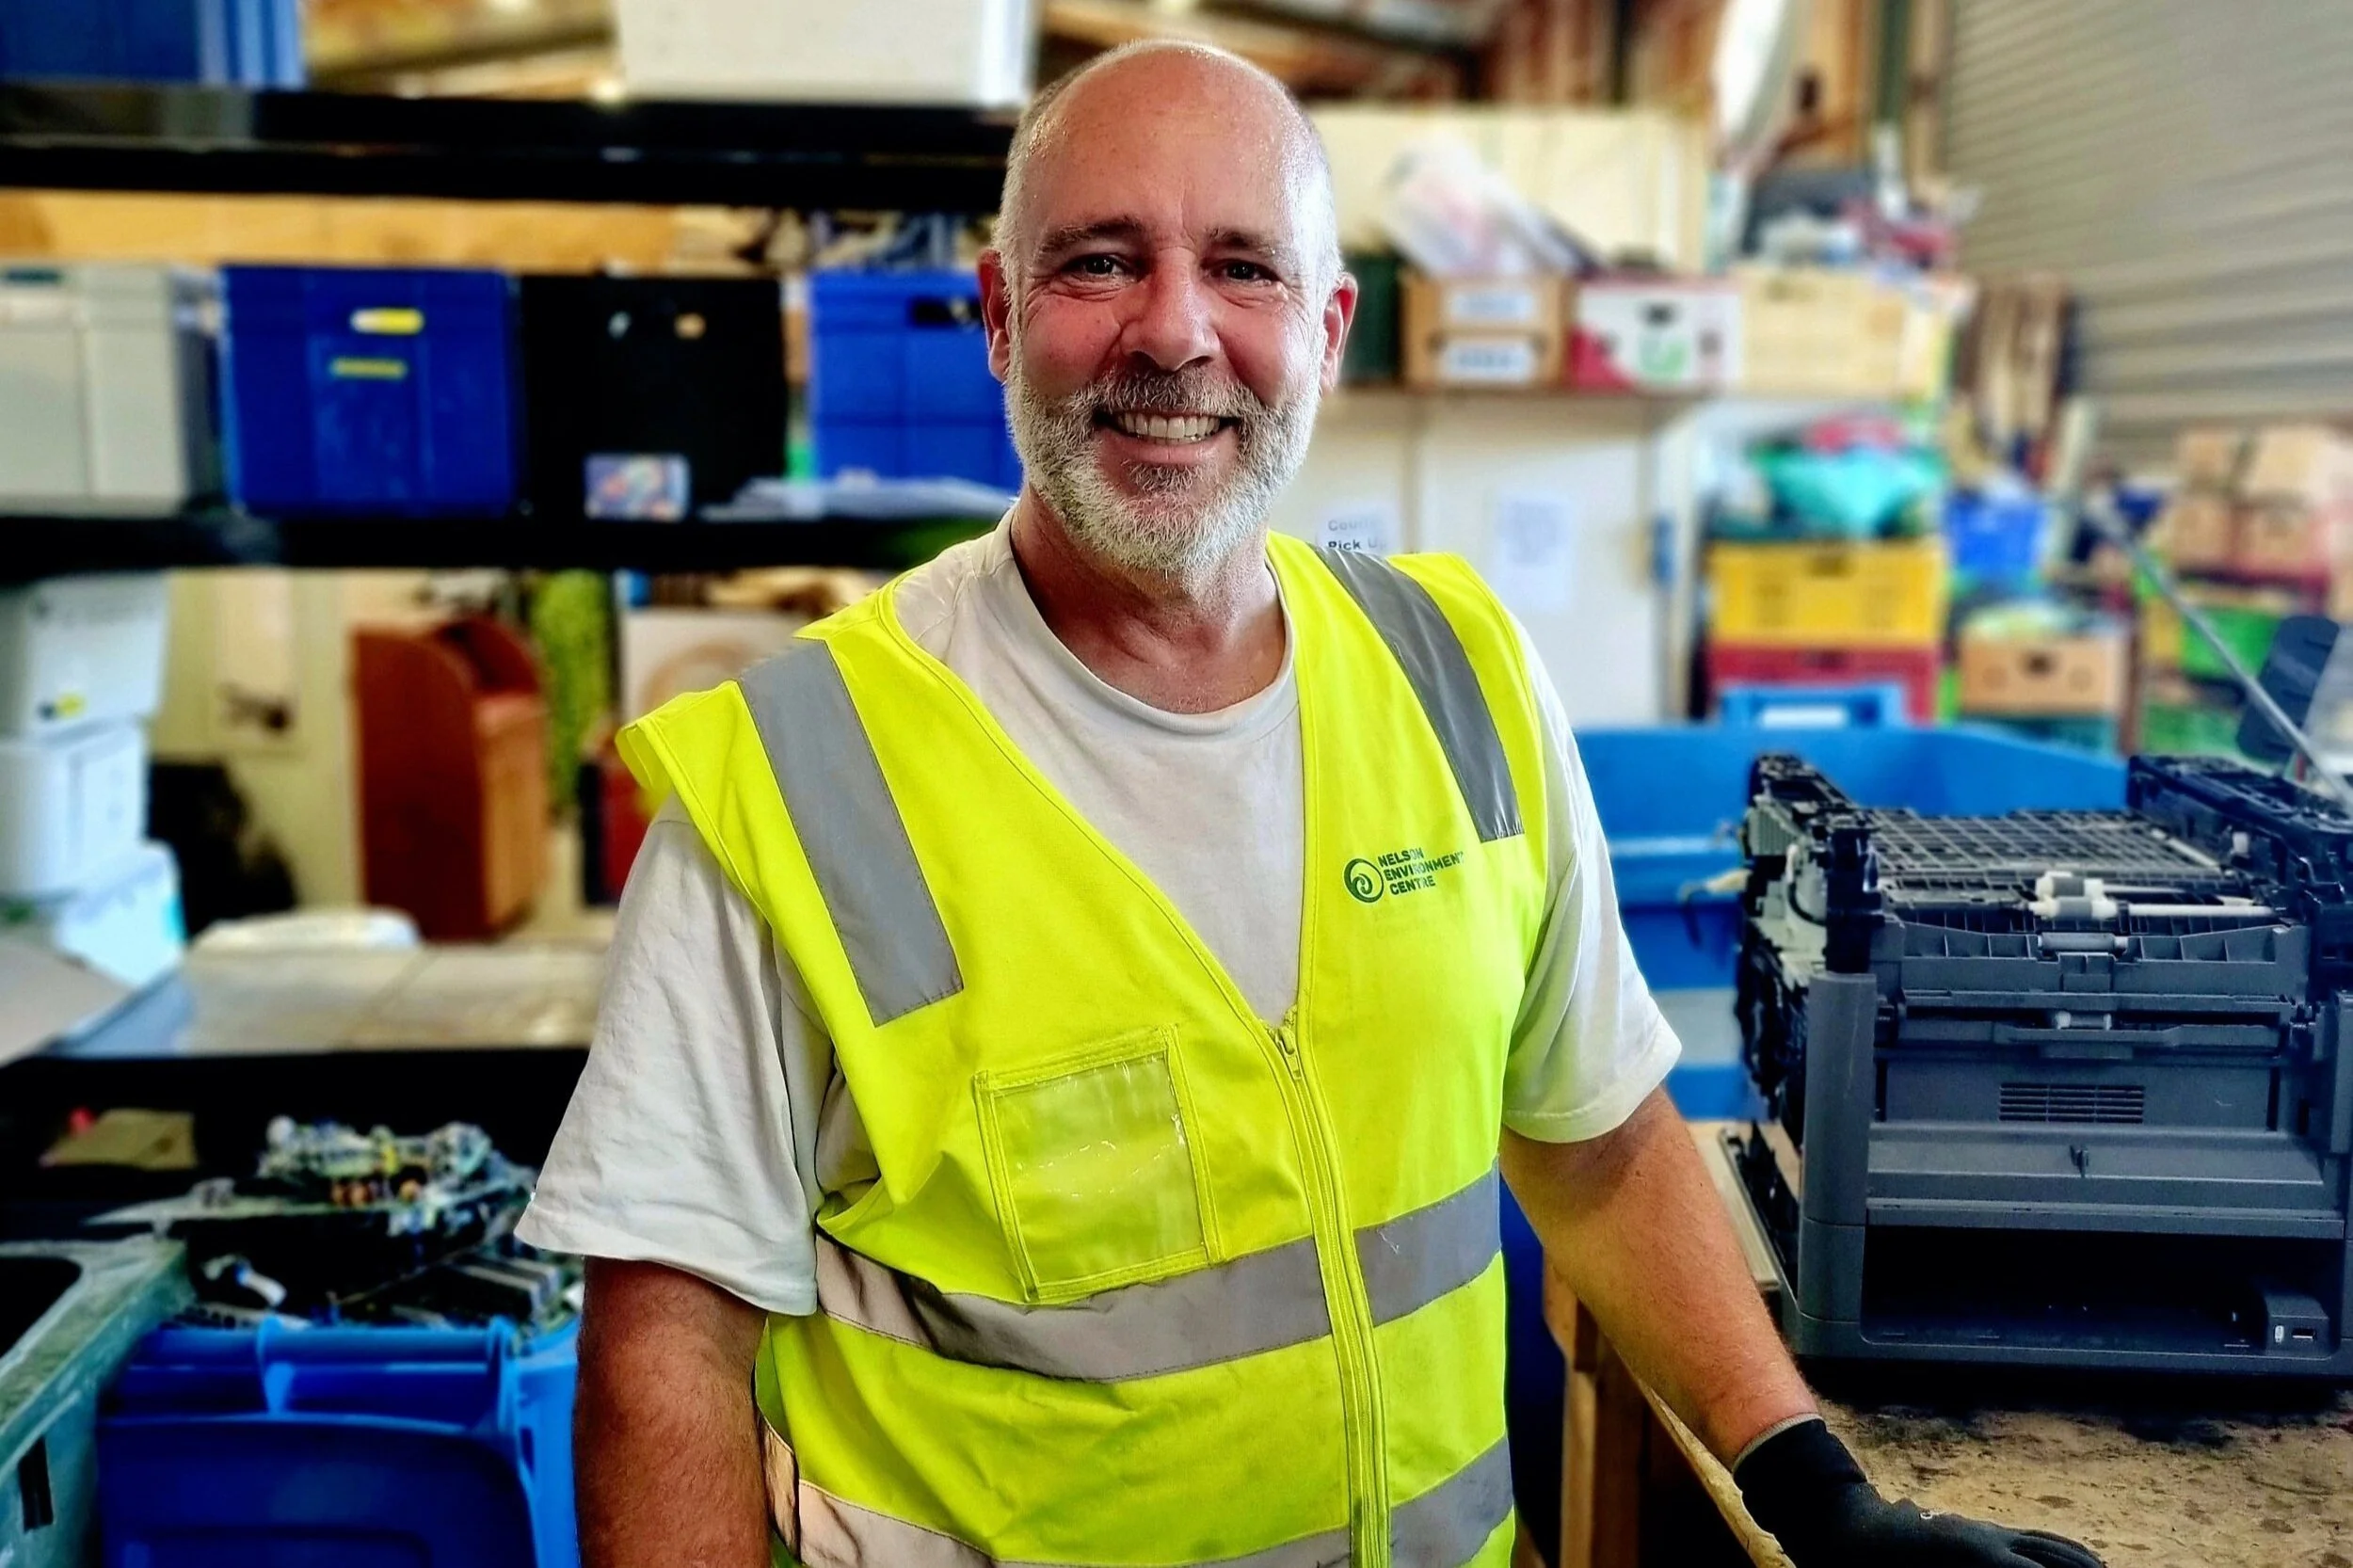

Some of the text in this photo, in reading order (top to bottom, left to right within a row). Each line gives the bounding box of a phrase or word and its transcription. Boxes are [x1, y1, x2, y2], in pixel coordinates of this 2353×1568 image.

[1327, 538, 1362, 551] Pick
[1377, 847, 1424, 868] NELSON
[1389, 875, 1436, 895] CENTRE
